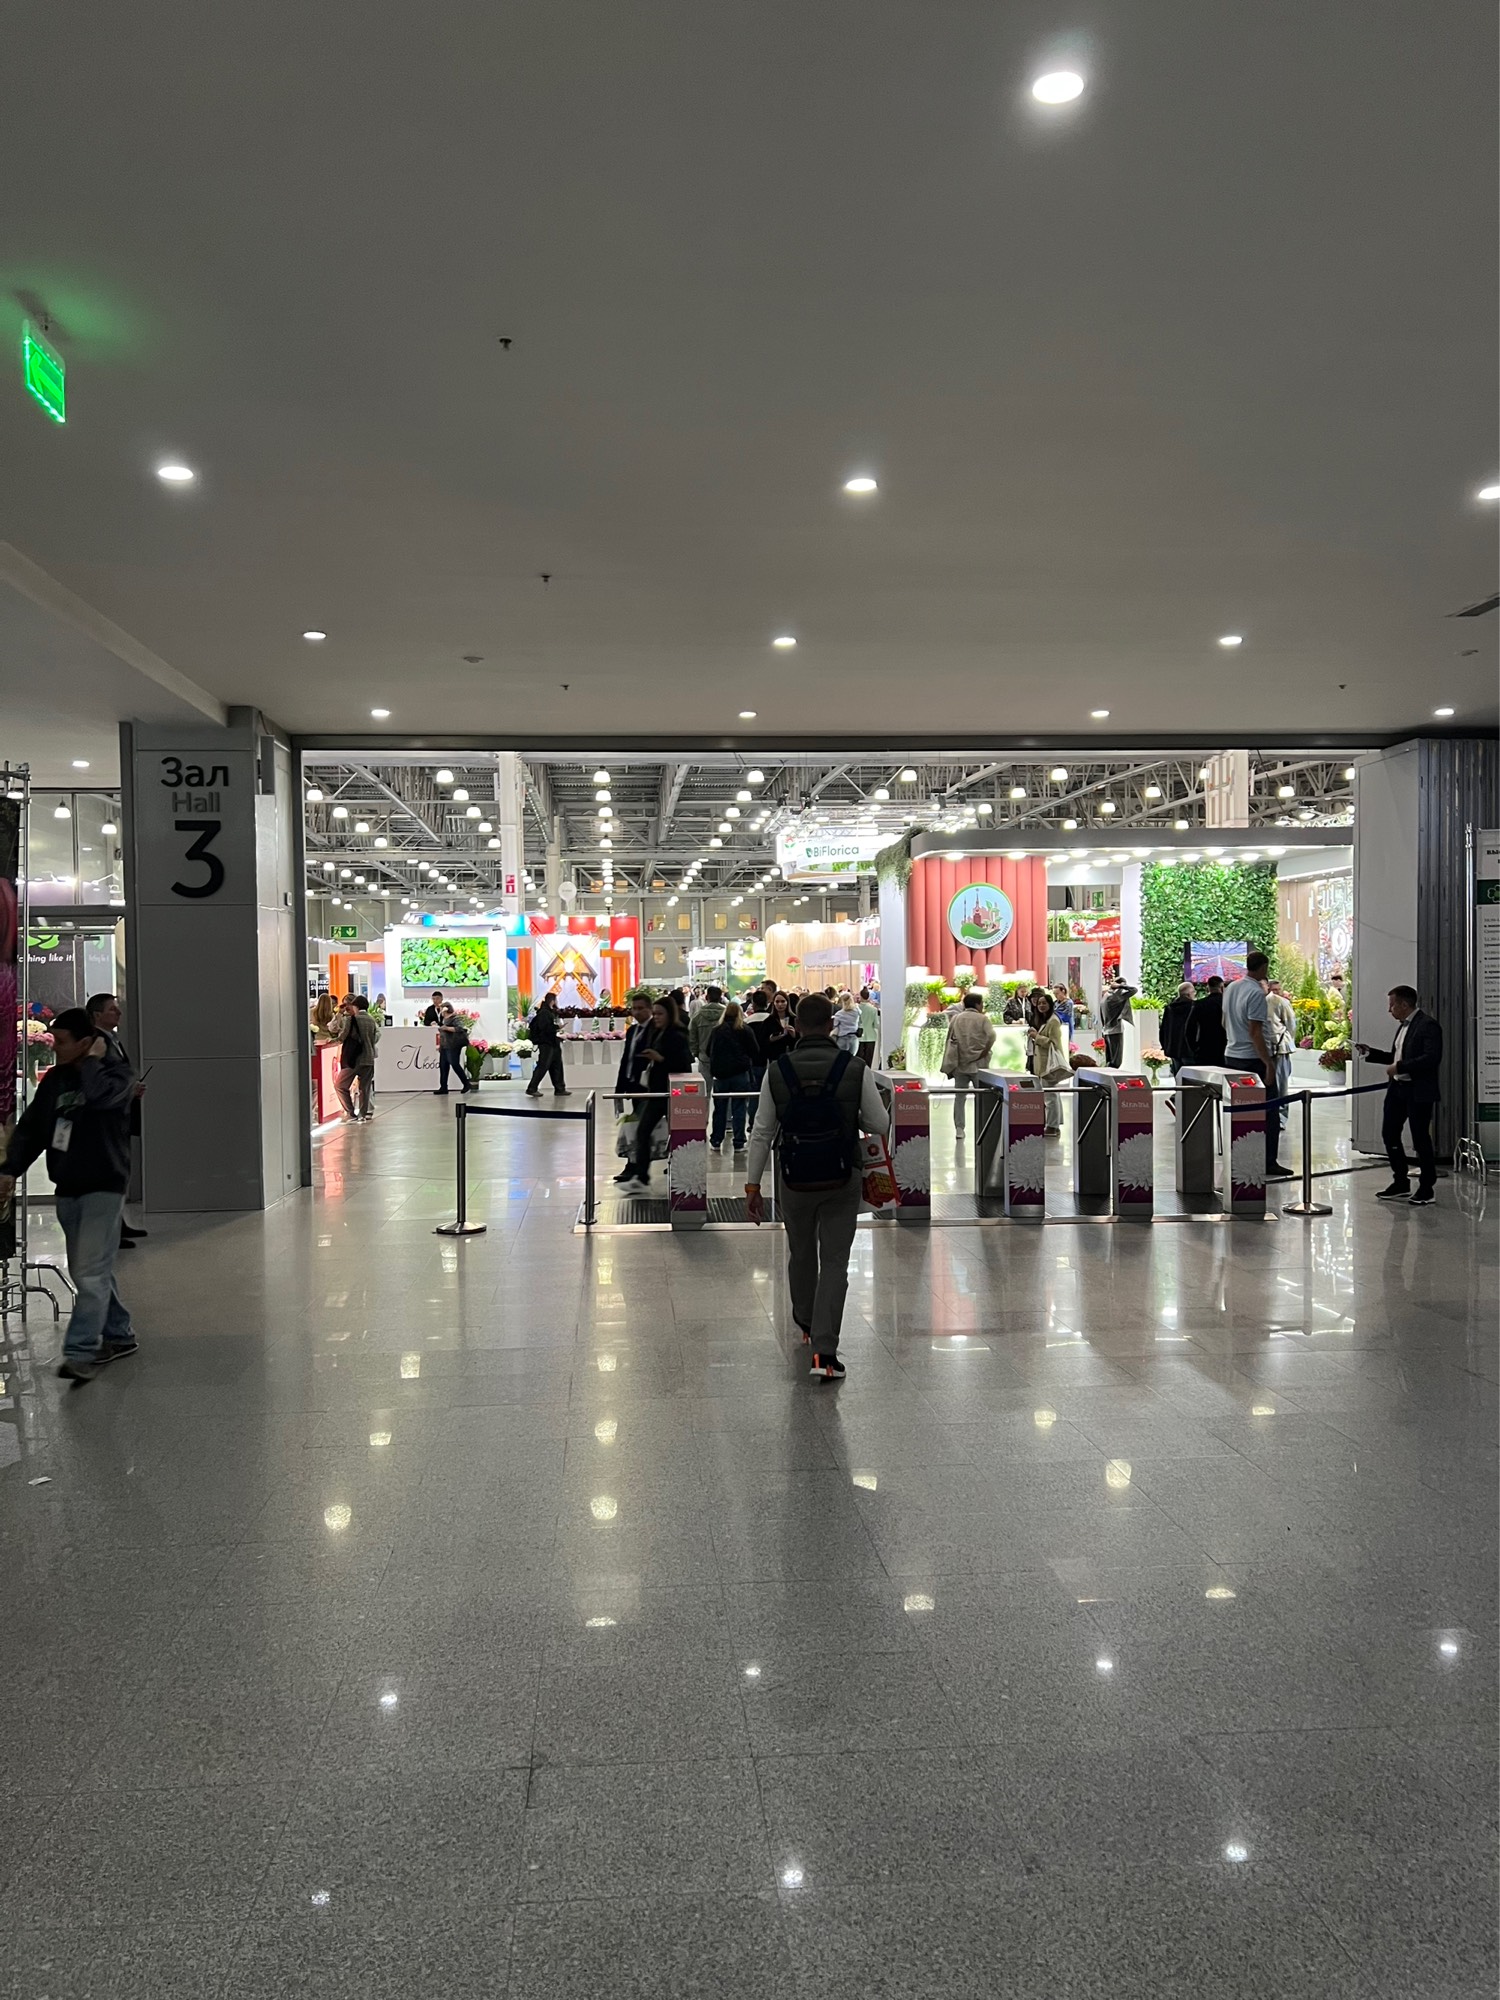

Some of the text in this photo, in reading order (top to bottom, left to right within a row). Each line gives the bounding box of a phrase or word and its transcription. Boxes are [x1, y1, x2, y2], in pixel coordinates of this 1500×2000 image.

[161, 756, 229, 788] Зал
[172, 791, 220, 813] Hall
[170, 819, 225, 899] 3
[813, 845, 859, 858] BiFlorica
[48, 953, 64, 962] like
